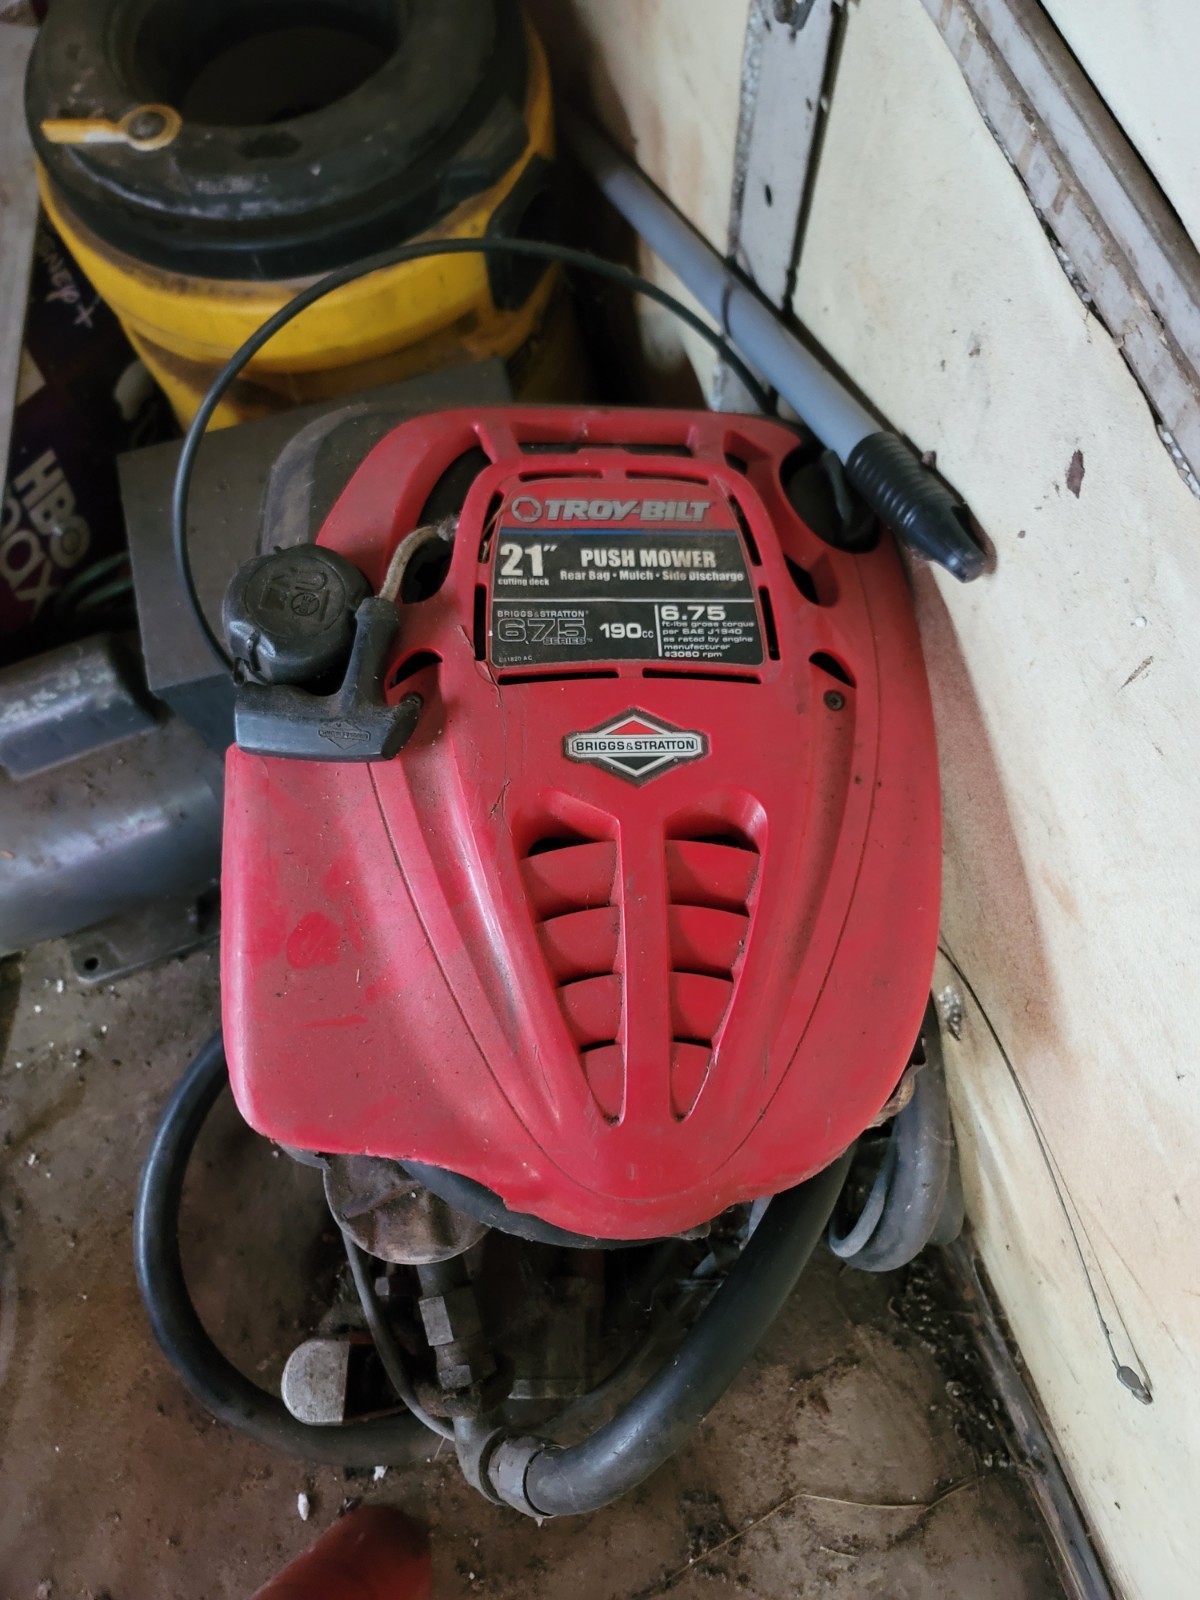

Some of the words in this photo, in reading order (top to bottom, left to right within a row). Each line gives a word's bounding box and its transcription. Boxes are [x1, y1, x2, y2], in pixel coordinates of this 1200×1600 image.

[14, 447, 91, 569] HBO
[545, 499, 710, 522] TROY-BILT
[580, 549, 636, 568] PUSH
[639, 549, 717, 568] MOWER
[497, 577, 528, 587] cutting
[528, 577, 550, 586] deck
[560, 569, 587, 581] Rear
[588, 569, 611, 582] Bag
[619, 570, 654, 581] Mulch
[662, 570, 687, 581] Side
[688, 571, 745, 582] Discharge
[661, 605, 726, 621] 6.75
[498, 618, 587, 642] 675
[542, 637, 587, 646] SERIES
